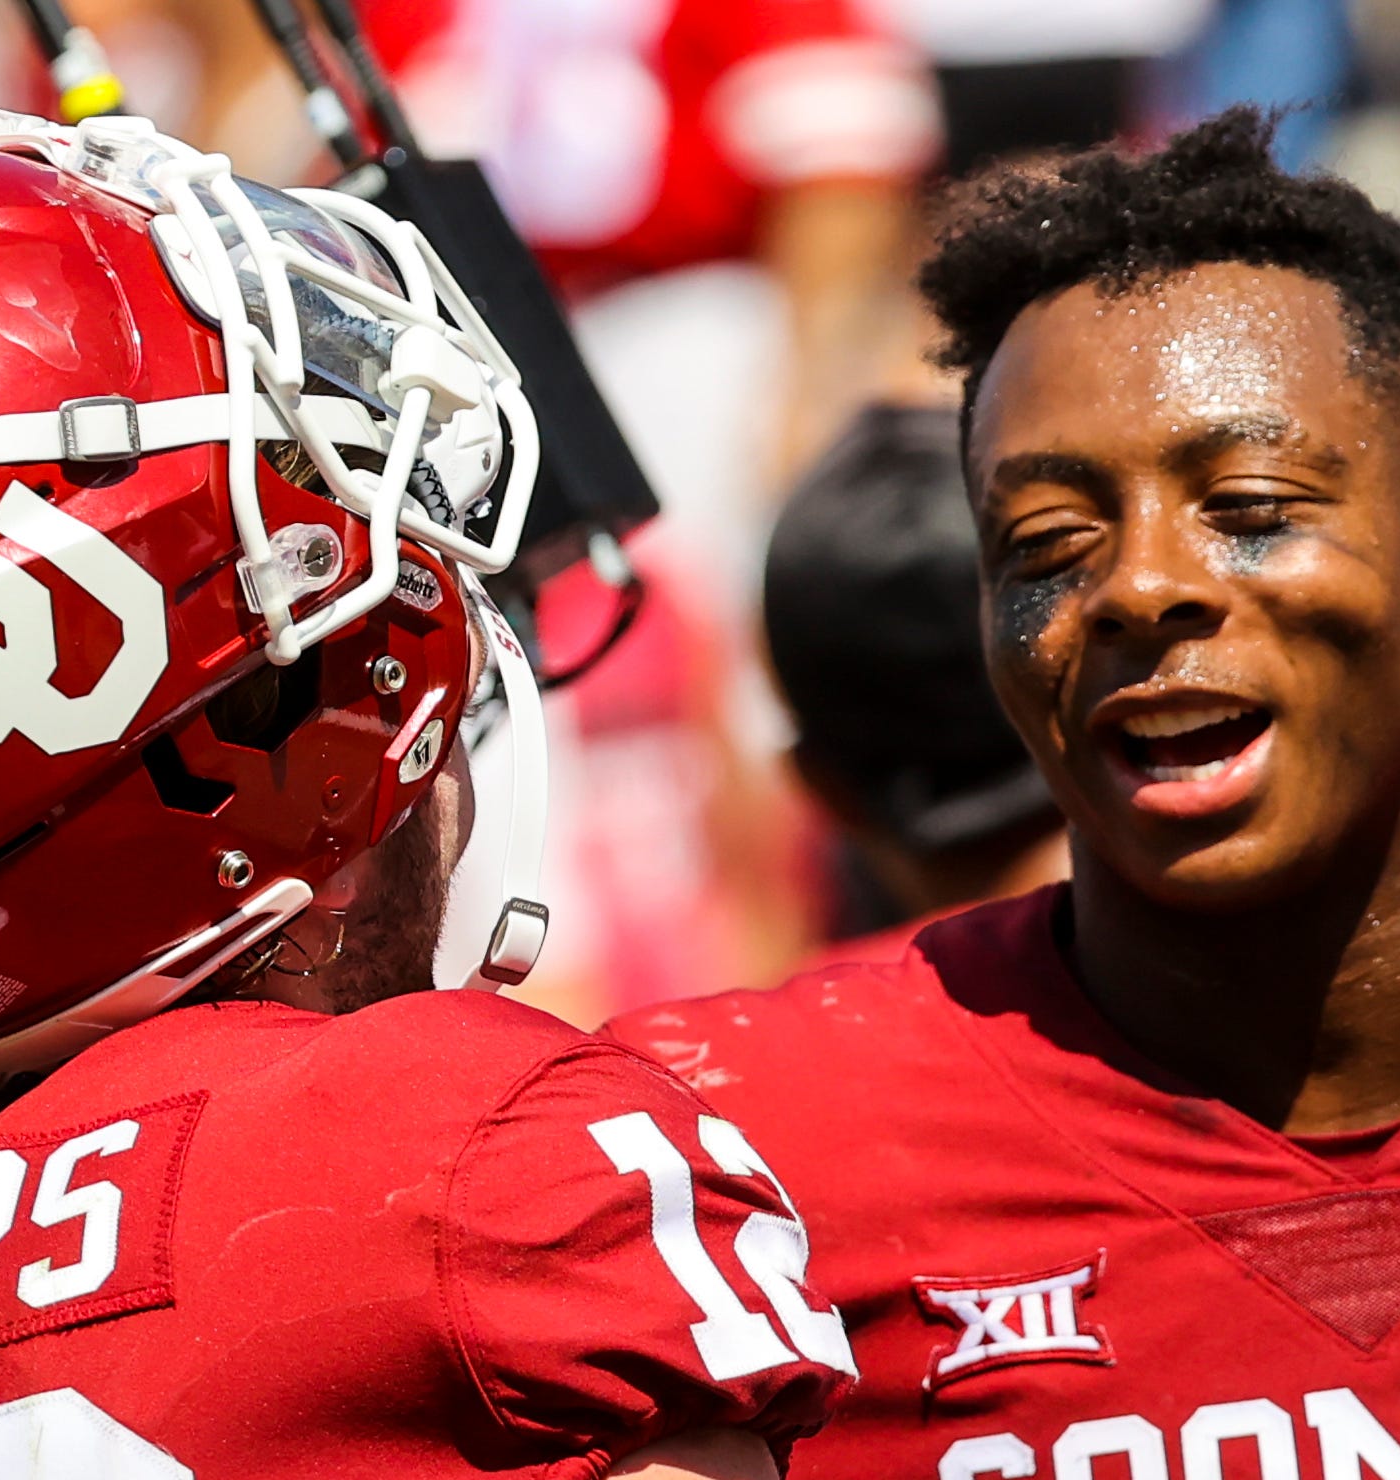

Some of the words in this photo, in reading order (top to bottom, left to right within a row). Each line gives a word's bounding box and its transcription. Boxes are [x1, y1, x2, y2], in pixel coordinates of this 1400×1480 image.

[395, 572, 435, 599] chutt
[587, 1111, 861, 1382] 12
[928, 1265, 1101, 1375] XII
